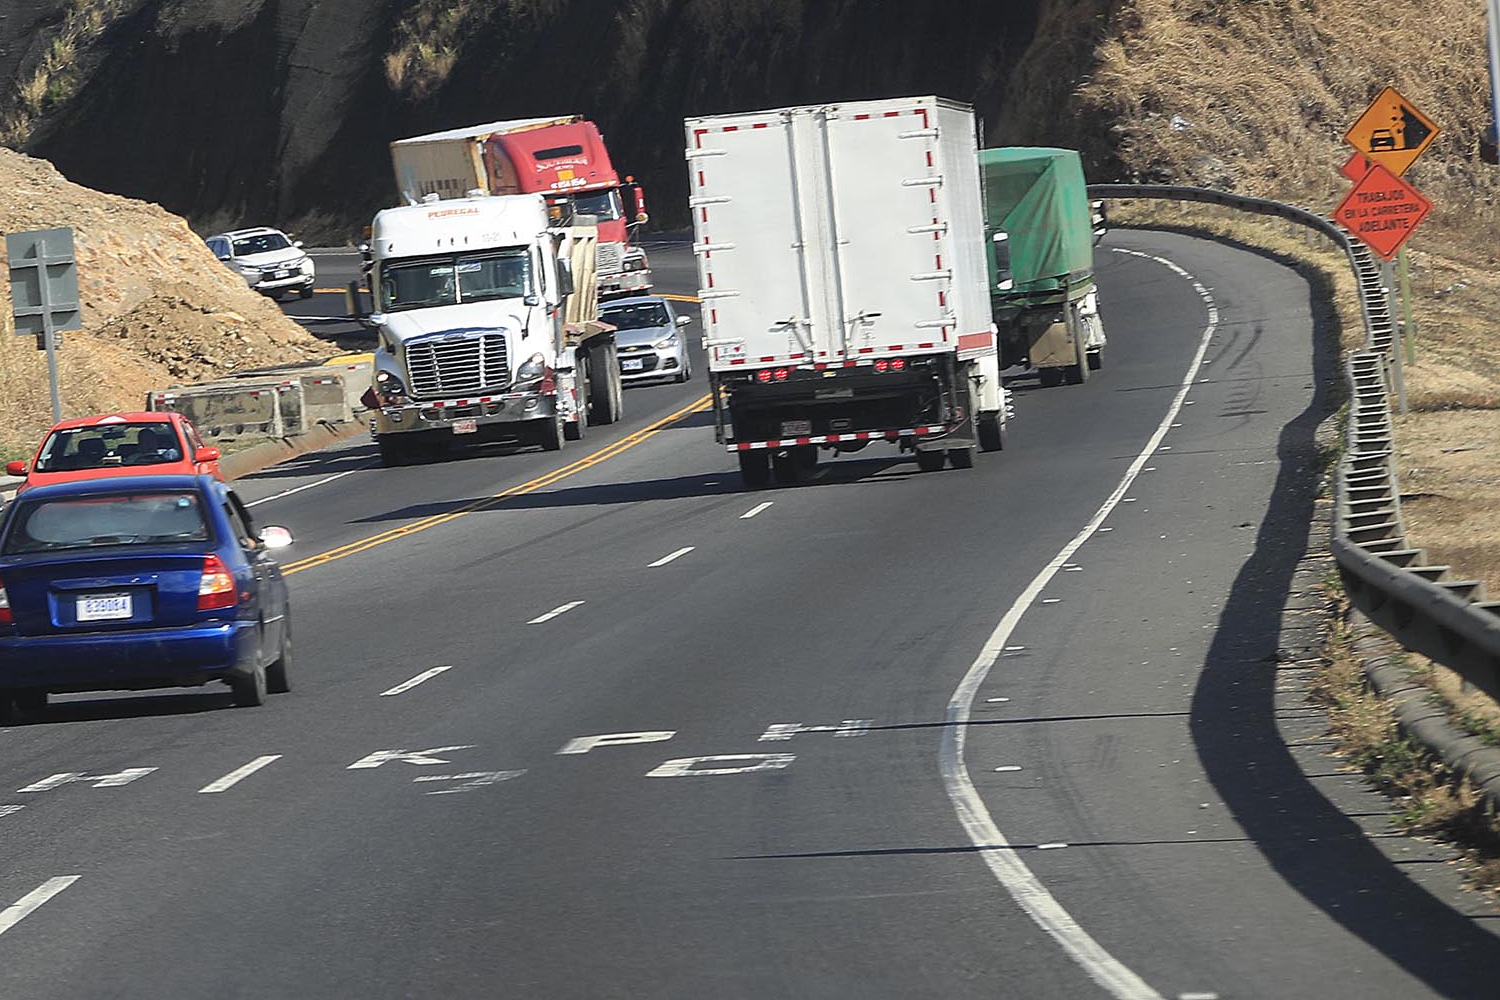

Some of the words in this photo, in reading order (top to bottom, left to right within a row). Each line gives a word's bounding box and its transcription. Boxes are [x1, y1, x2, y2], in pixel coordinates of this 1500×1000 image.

[1357, 190, 1404, 203] TRABAJOS
[1345, 209, 1356, 219] EN
[1357, 208, 1368, 218] LA
[1372, 203, 1420, 216] CARRETERA
[1360, 218, 1410, 232] ADELANTE
